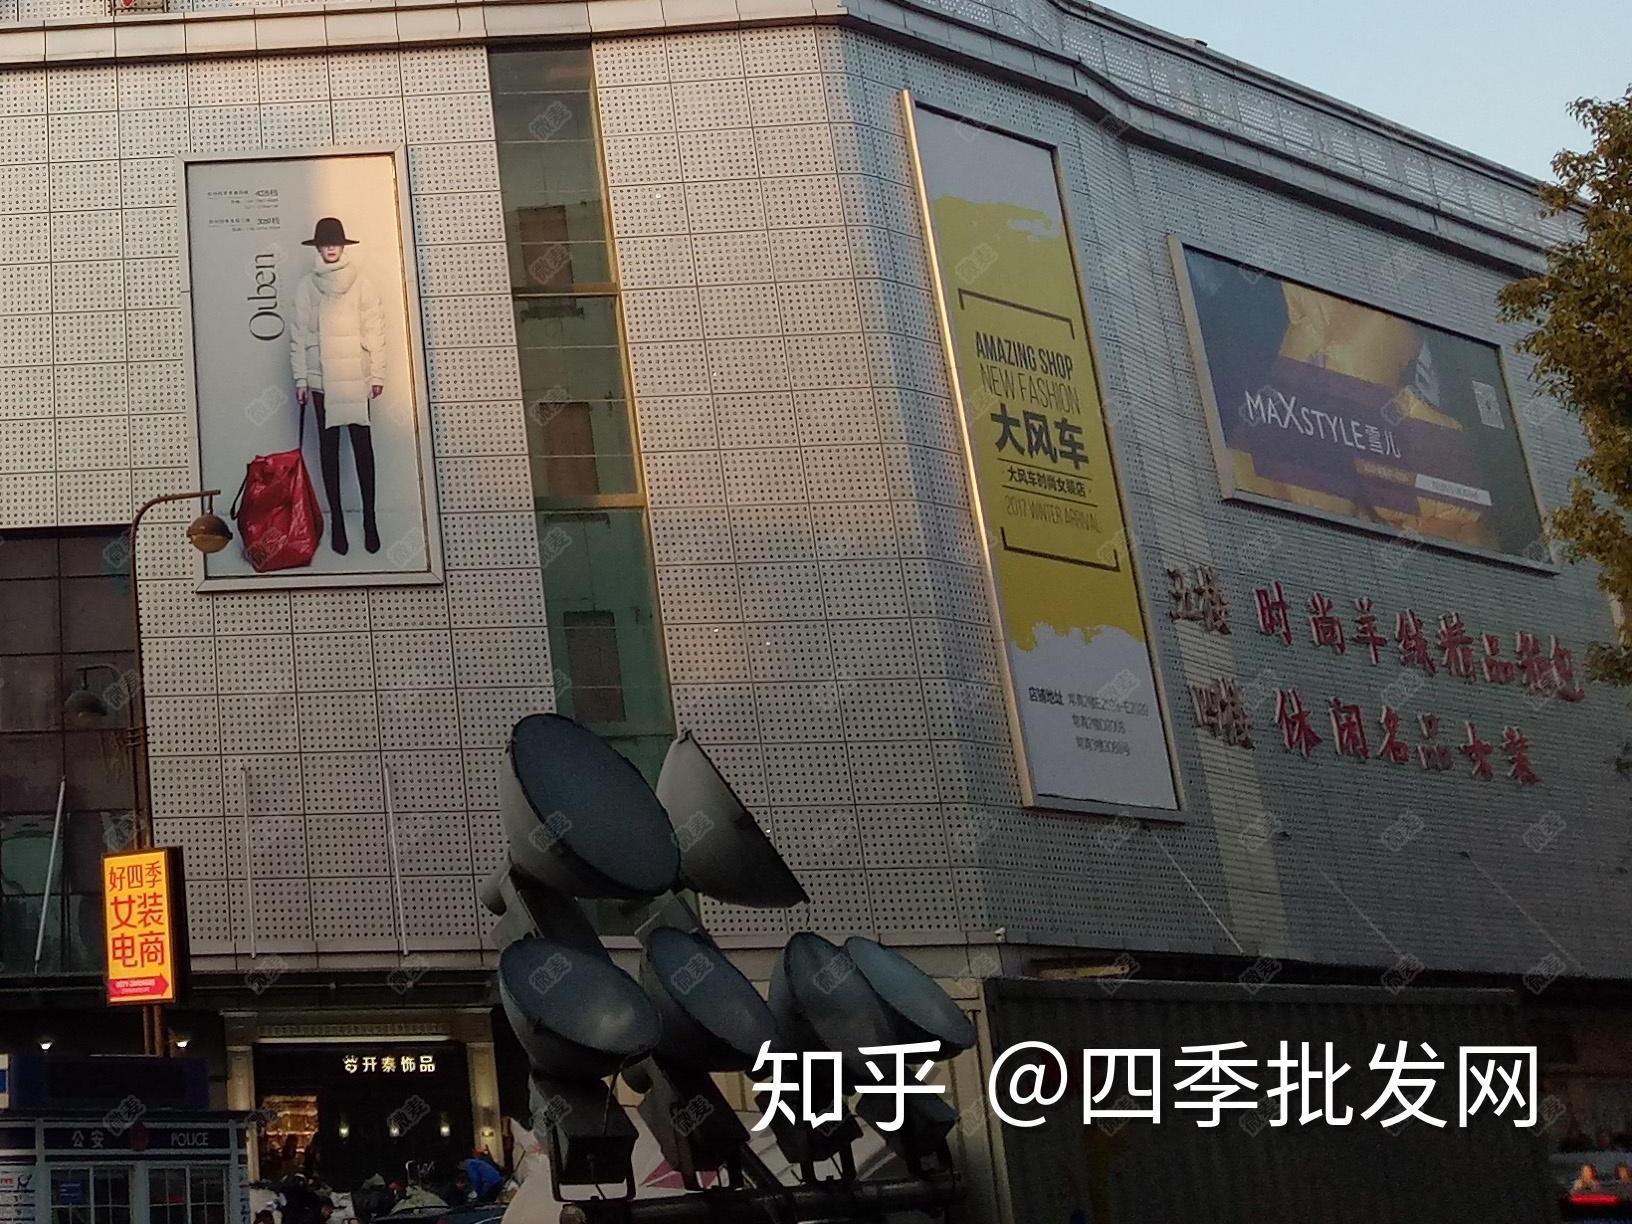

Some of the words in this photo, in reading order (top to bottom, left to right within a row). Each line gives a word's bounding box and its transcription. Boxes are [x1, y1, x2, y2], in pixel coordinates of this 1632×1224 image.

[248, 252, 286, 343] Ouben
[975, 331, 1038, 372] AMAZING
[1038, 348, 1074, 381] SHOP
[979, 363, 1016, 401] NEW
[1017, 372, 1082, 416] FASHION
[990, 402, 1090, 471] 大风车
[109, 860, 162, 892] 好四季
[110, 891, 165, 931] 女装
[111, 930, 166, 969] 电商
[71, 1129, 105, 1150] 公安
[170, 1131, 209, 1147] POLICE
